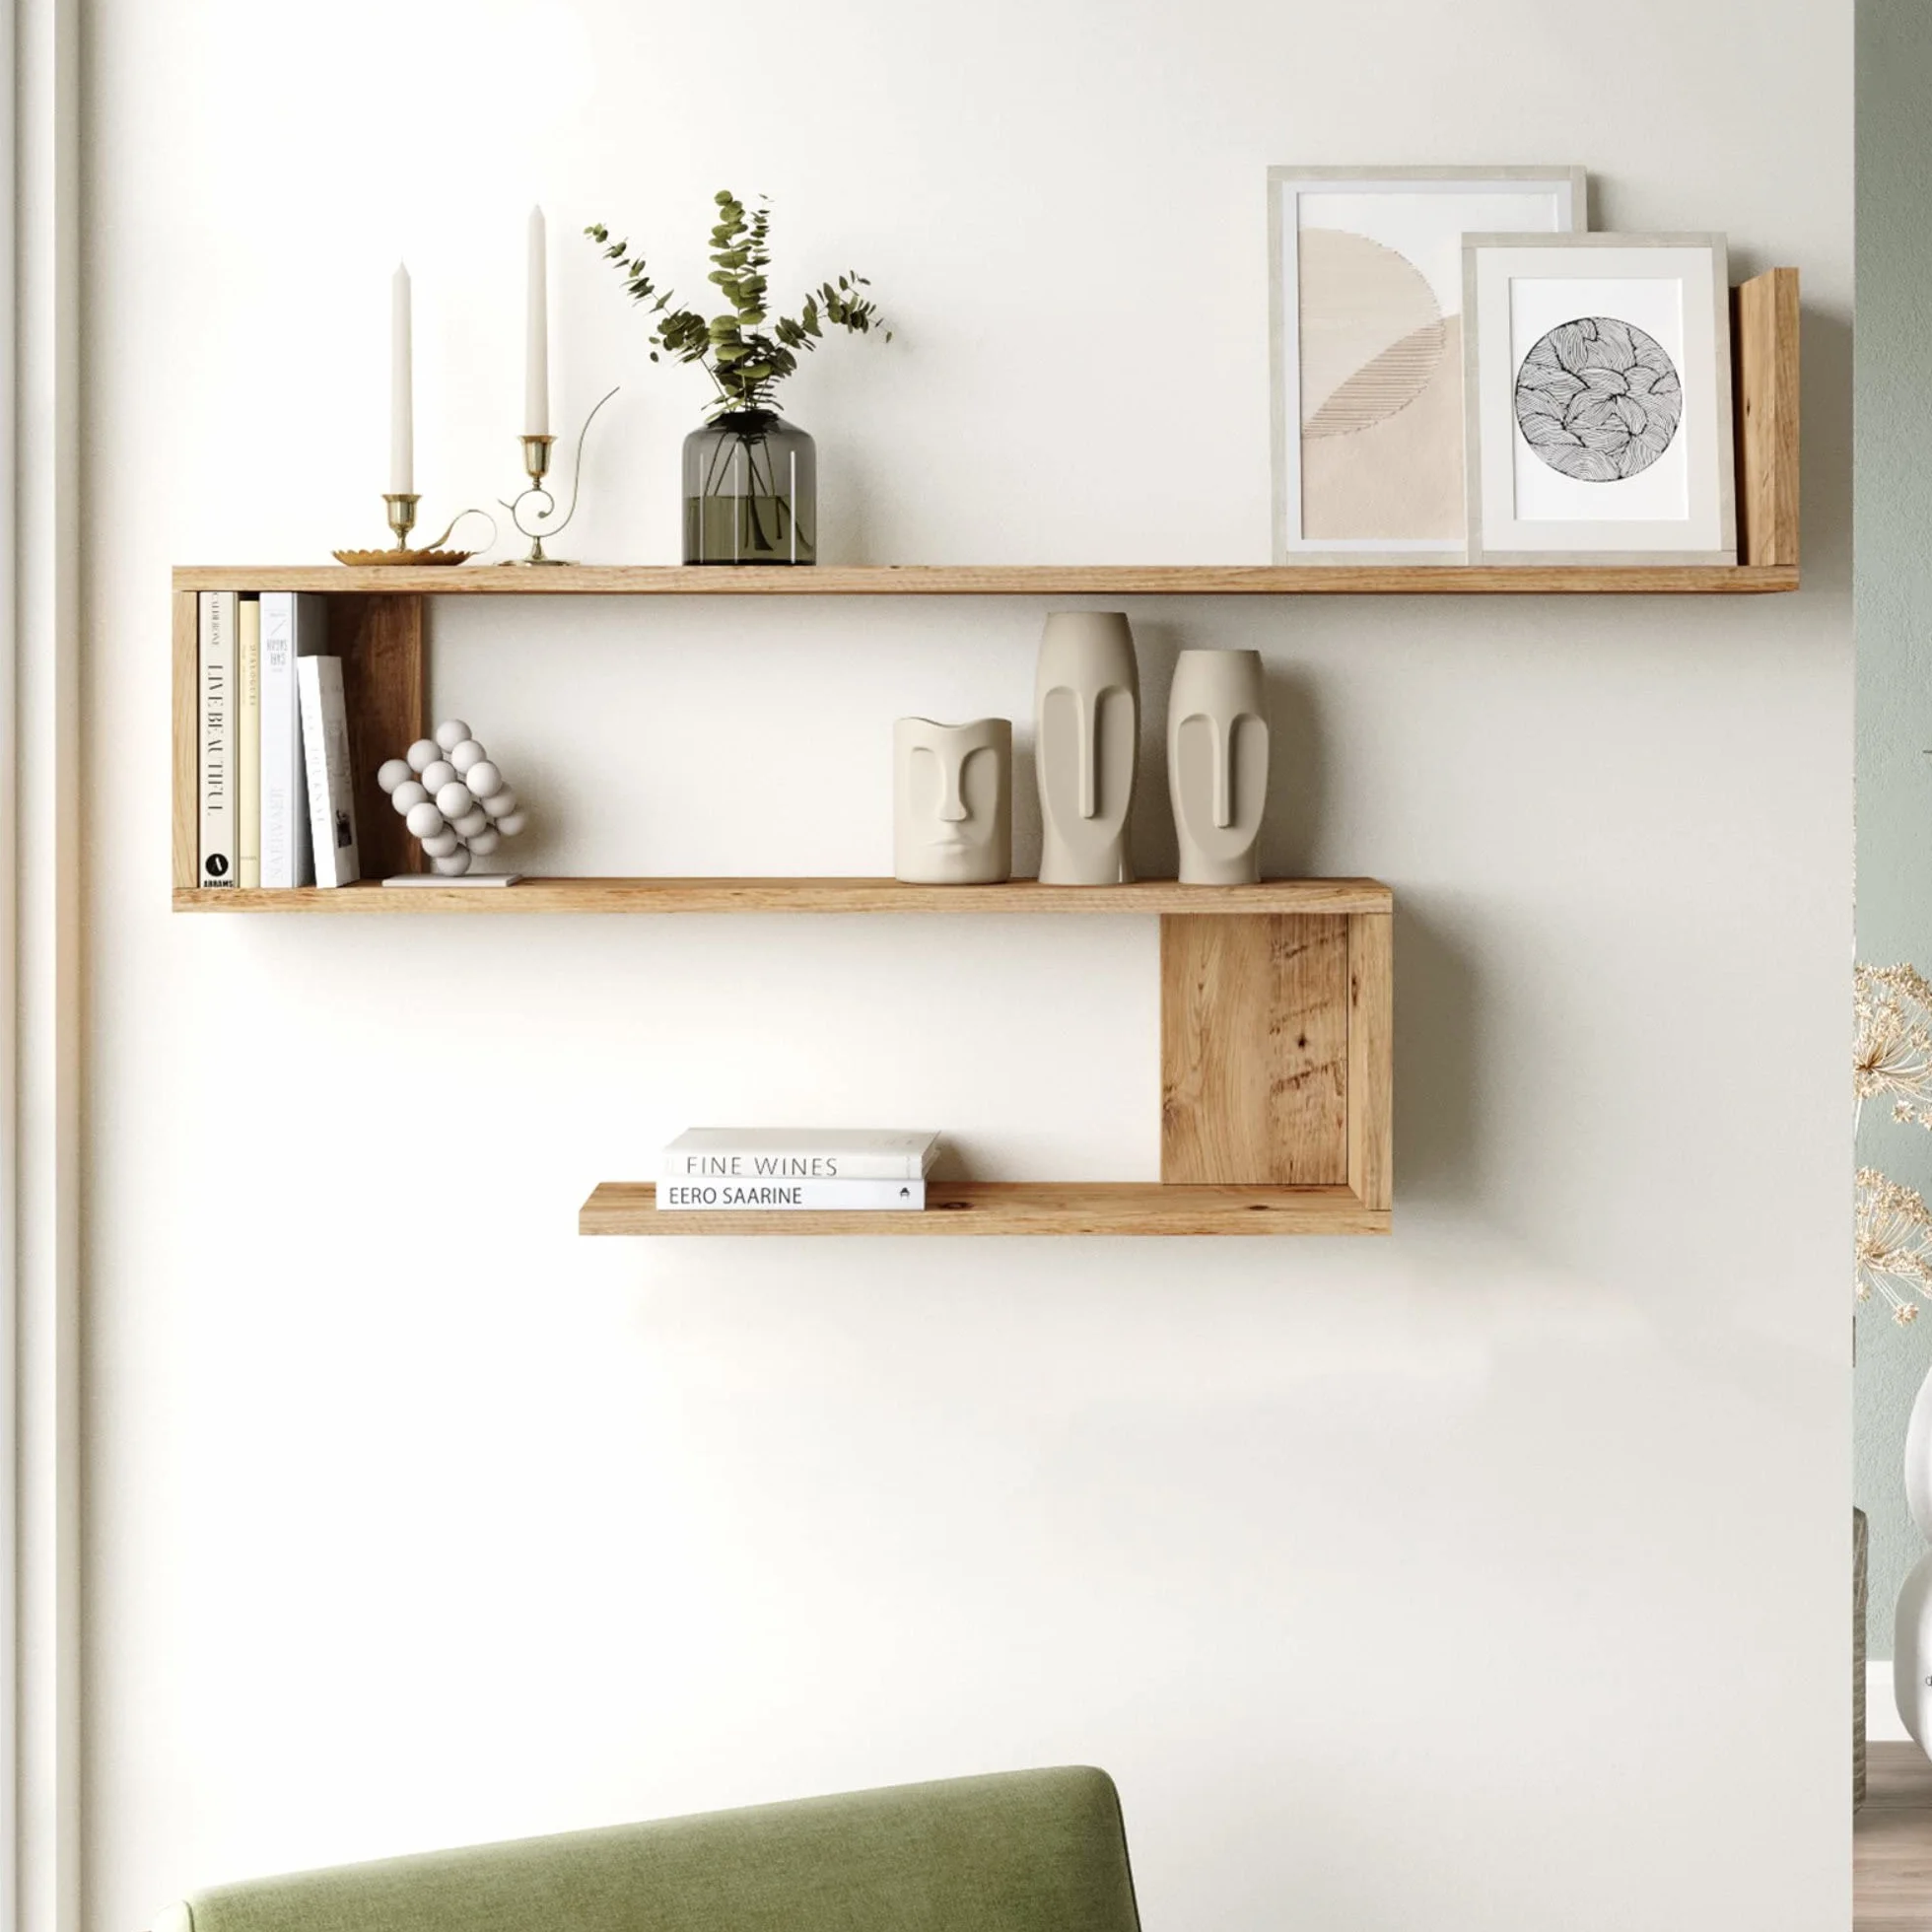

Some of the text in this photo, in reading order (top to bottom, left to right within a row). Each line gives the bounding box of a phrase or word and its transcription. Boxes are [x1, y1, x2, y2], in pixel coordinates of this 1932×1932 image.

[207, 664, 223, 816] LIVE BEAUTIFUL
[686, 1156, 838, 1177] FINE WINES
[669, 1187, 803, 1205] EERO SAARINE
